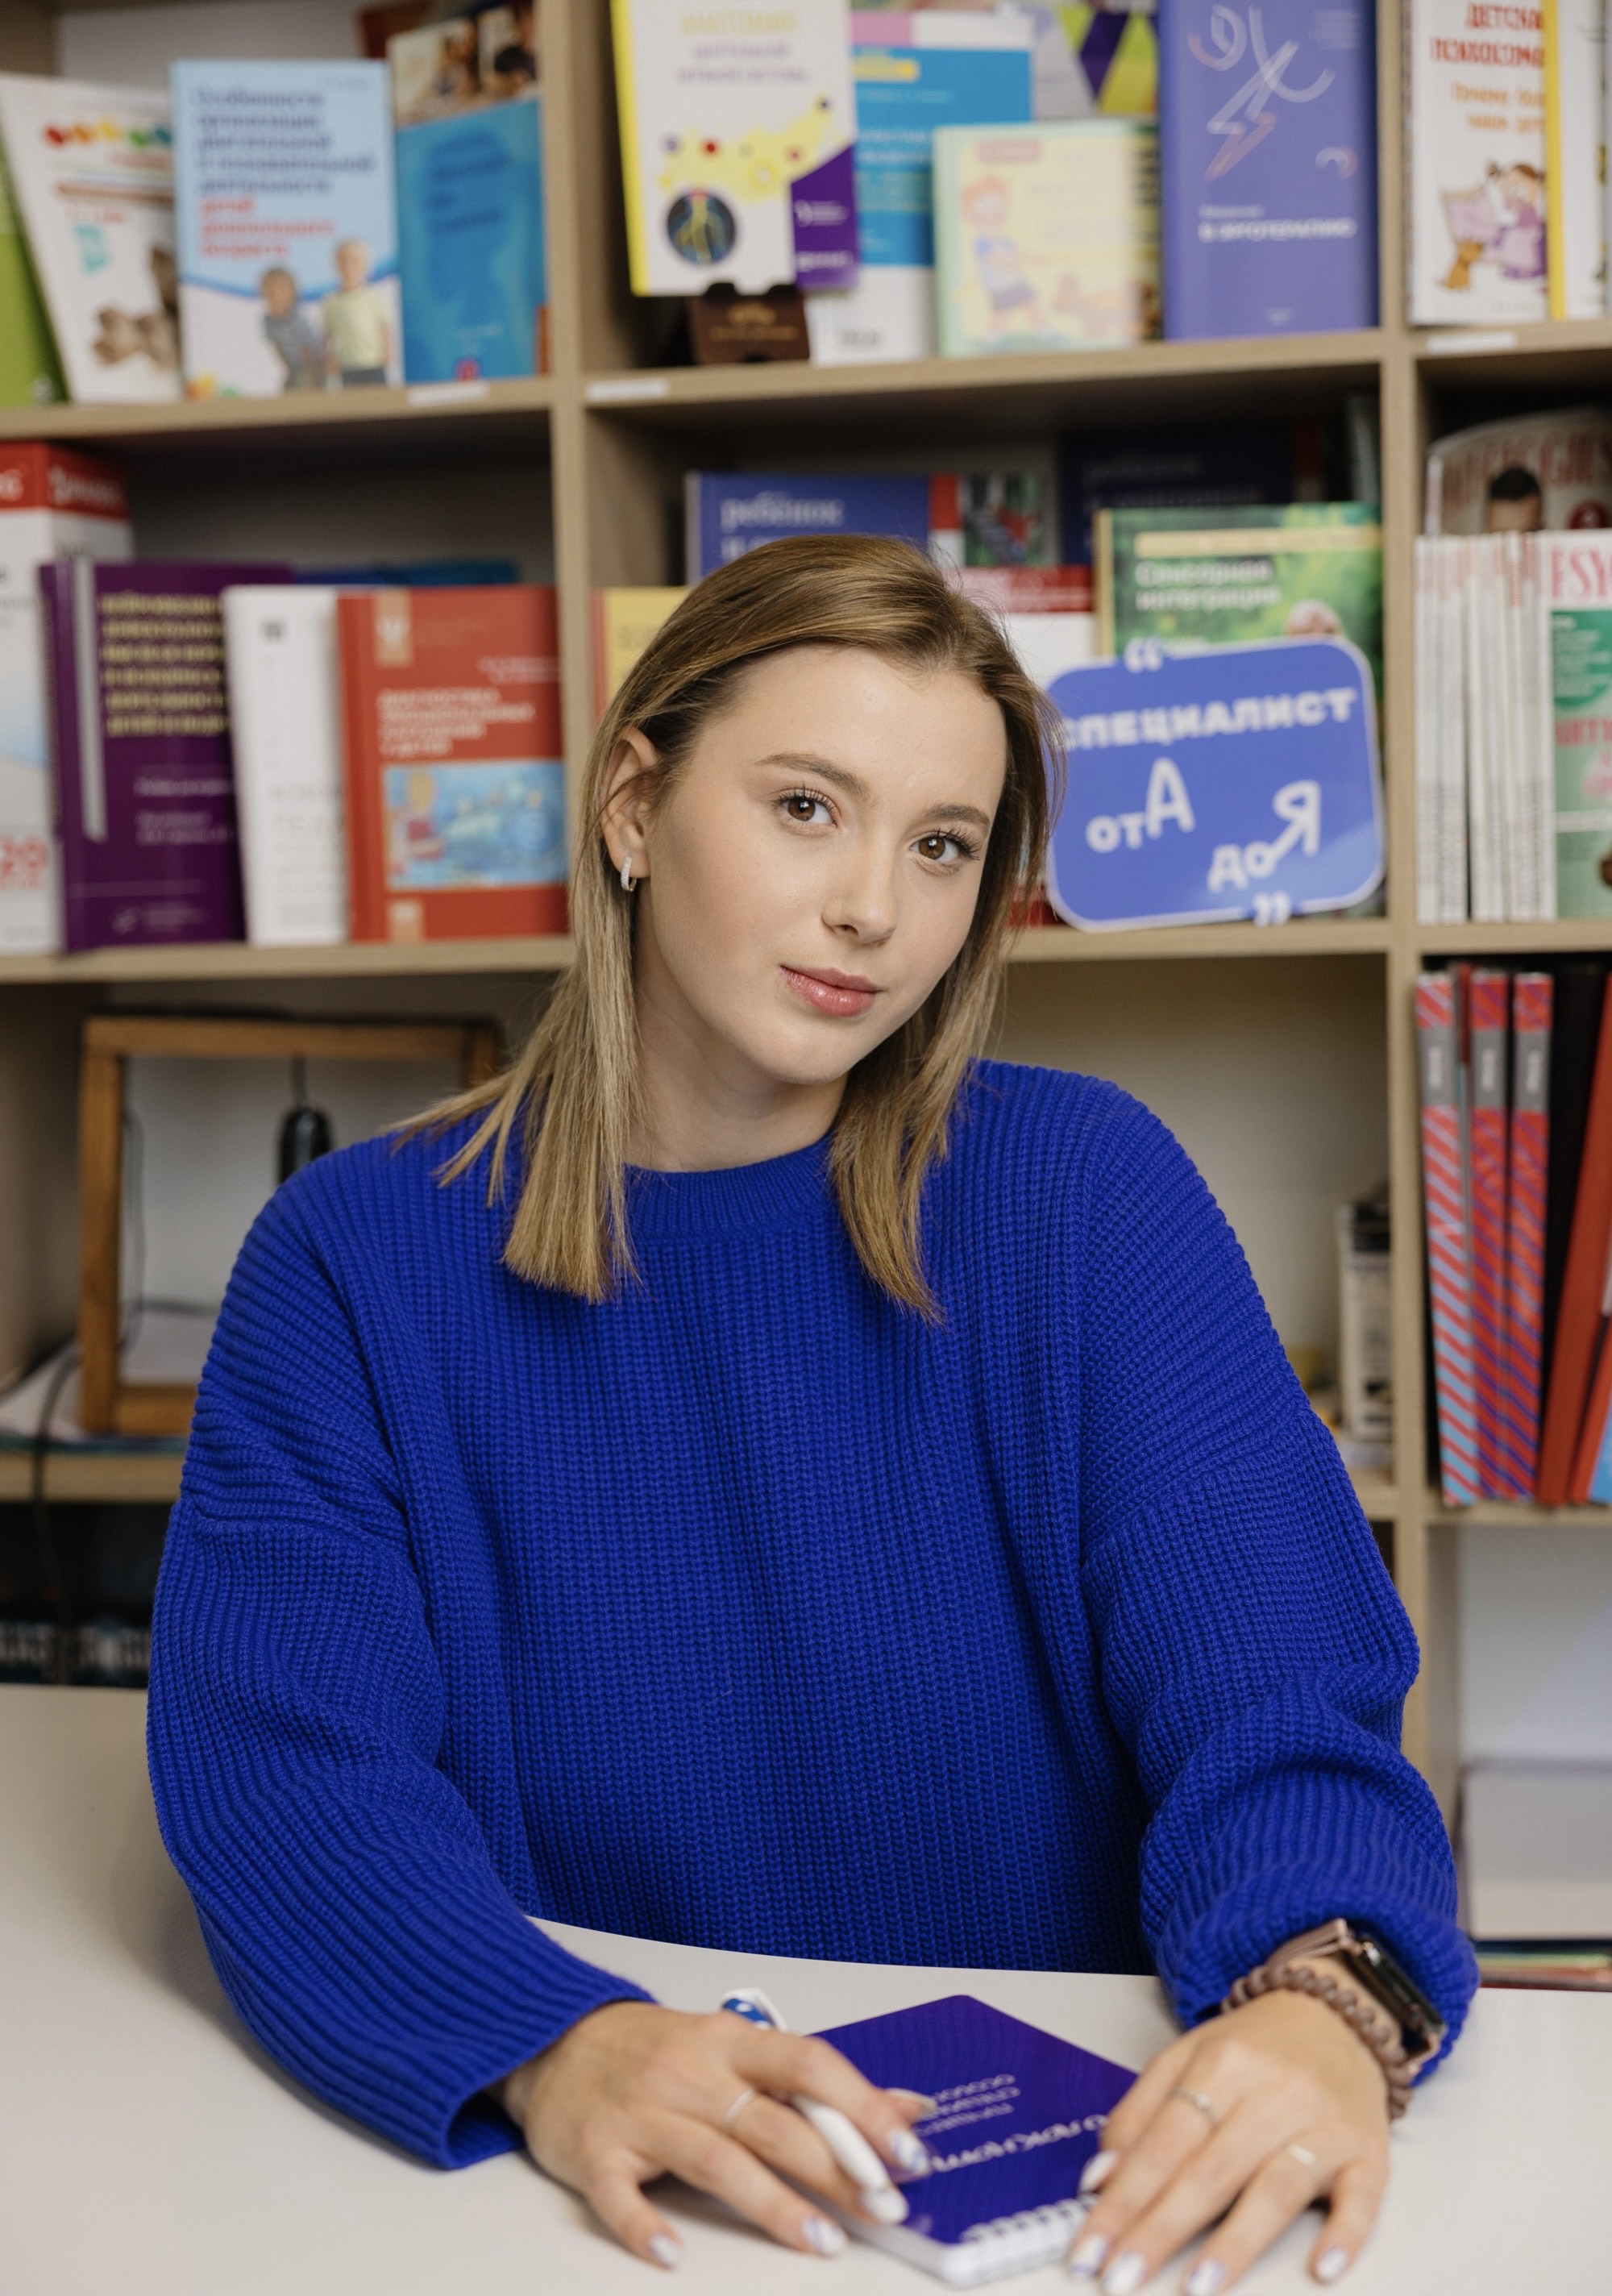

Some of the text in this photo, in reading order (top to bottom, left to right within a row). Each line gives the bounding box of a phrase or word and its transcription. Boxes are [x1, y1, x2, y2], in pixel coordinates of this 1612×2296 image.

[1465, 2, 1544, 31] ДЕТСКА
[1430, 35, 1545, 68] ПСИХОСОМА
[1134, 559, 1272, 589] Сенсорная
[1135, 587, 1282, 614] интеграция
[1086, 756, 1195, 853] от А
[1207, 780, 1322, 893] до Я
